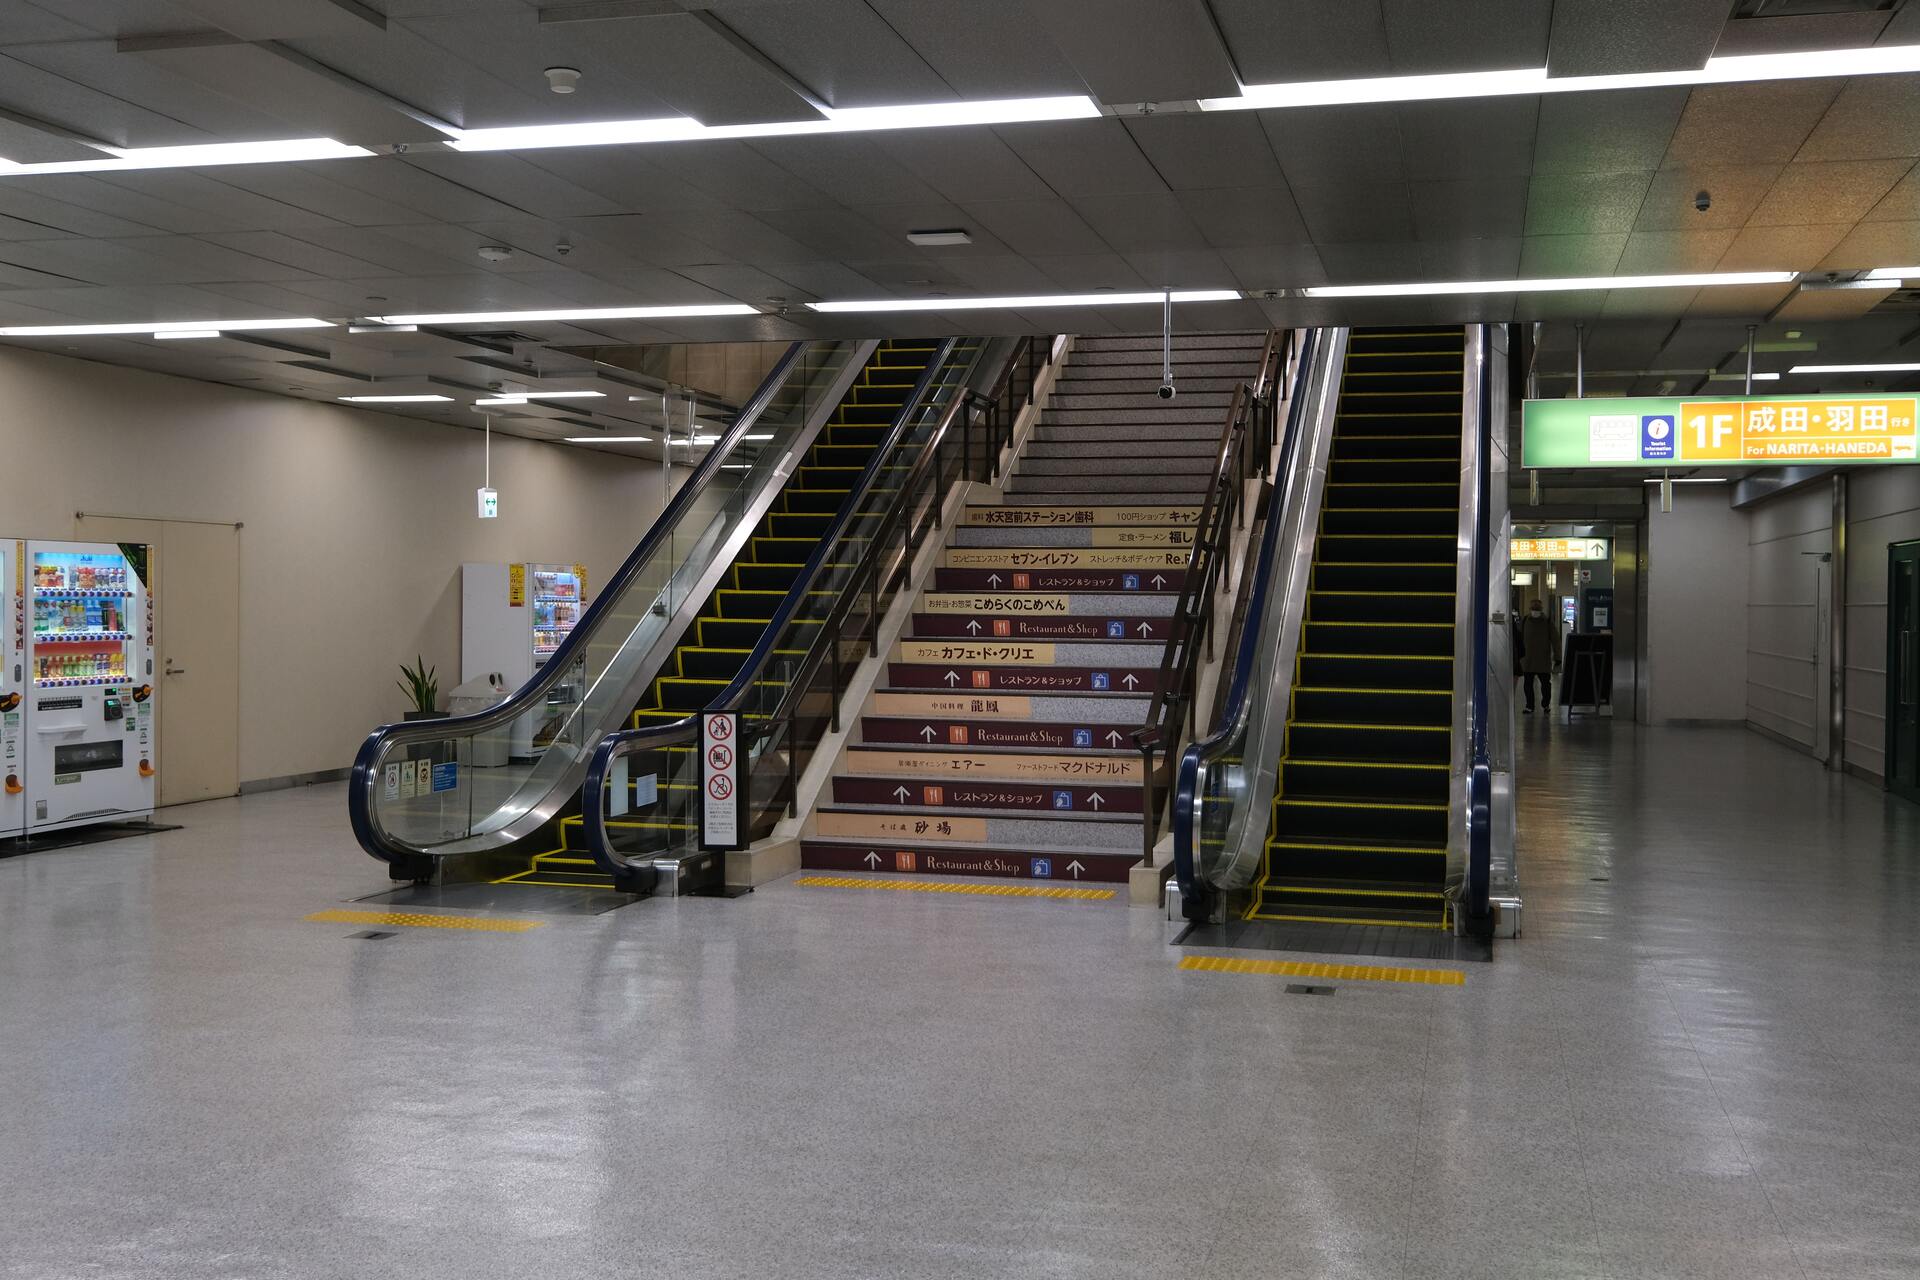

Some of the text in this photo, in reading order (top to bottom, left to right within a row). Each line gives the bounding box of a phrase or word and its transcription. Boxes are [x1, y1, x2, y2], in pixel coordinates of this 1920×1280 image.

[1688, 414, 1734, 449] 1F
[1746, 446, 1765, 455] For
[985, 511, 1094, 523] 水天宮前ステーション歯科
[1117, 512, 1167, 521] 100円ショップ
[1118, 533, 1168, 542] 定食・ラーメン
[952, 555, 1009, 563] コンビニエンスストア
[1039, 578, 1115, 586] レストラン&ショップ
[974, 598, 1066, 611] こめらくのこめべん
[1020, 622, 1098, 637] Restaurant&Shop
[918, 646, 1034, 660] カフェ カフェ・ド・クリエ
[1000, 676, 1082, 685] レストラン&ショップ
[977, 729, 1063, 745] Restaurant&Shop
[951, 760, 986, 770] エアー
[1059, 761, 1131, 775] マクドナルド
[953, 792, 1043, 804] レストラン&ショップ
[914, 820, 952, 835] 砂場
[927, 855, 1020, 875] Restaurant&Shop
